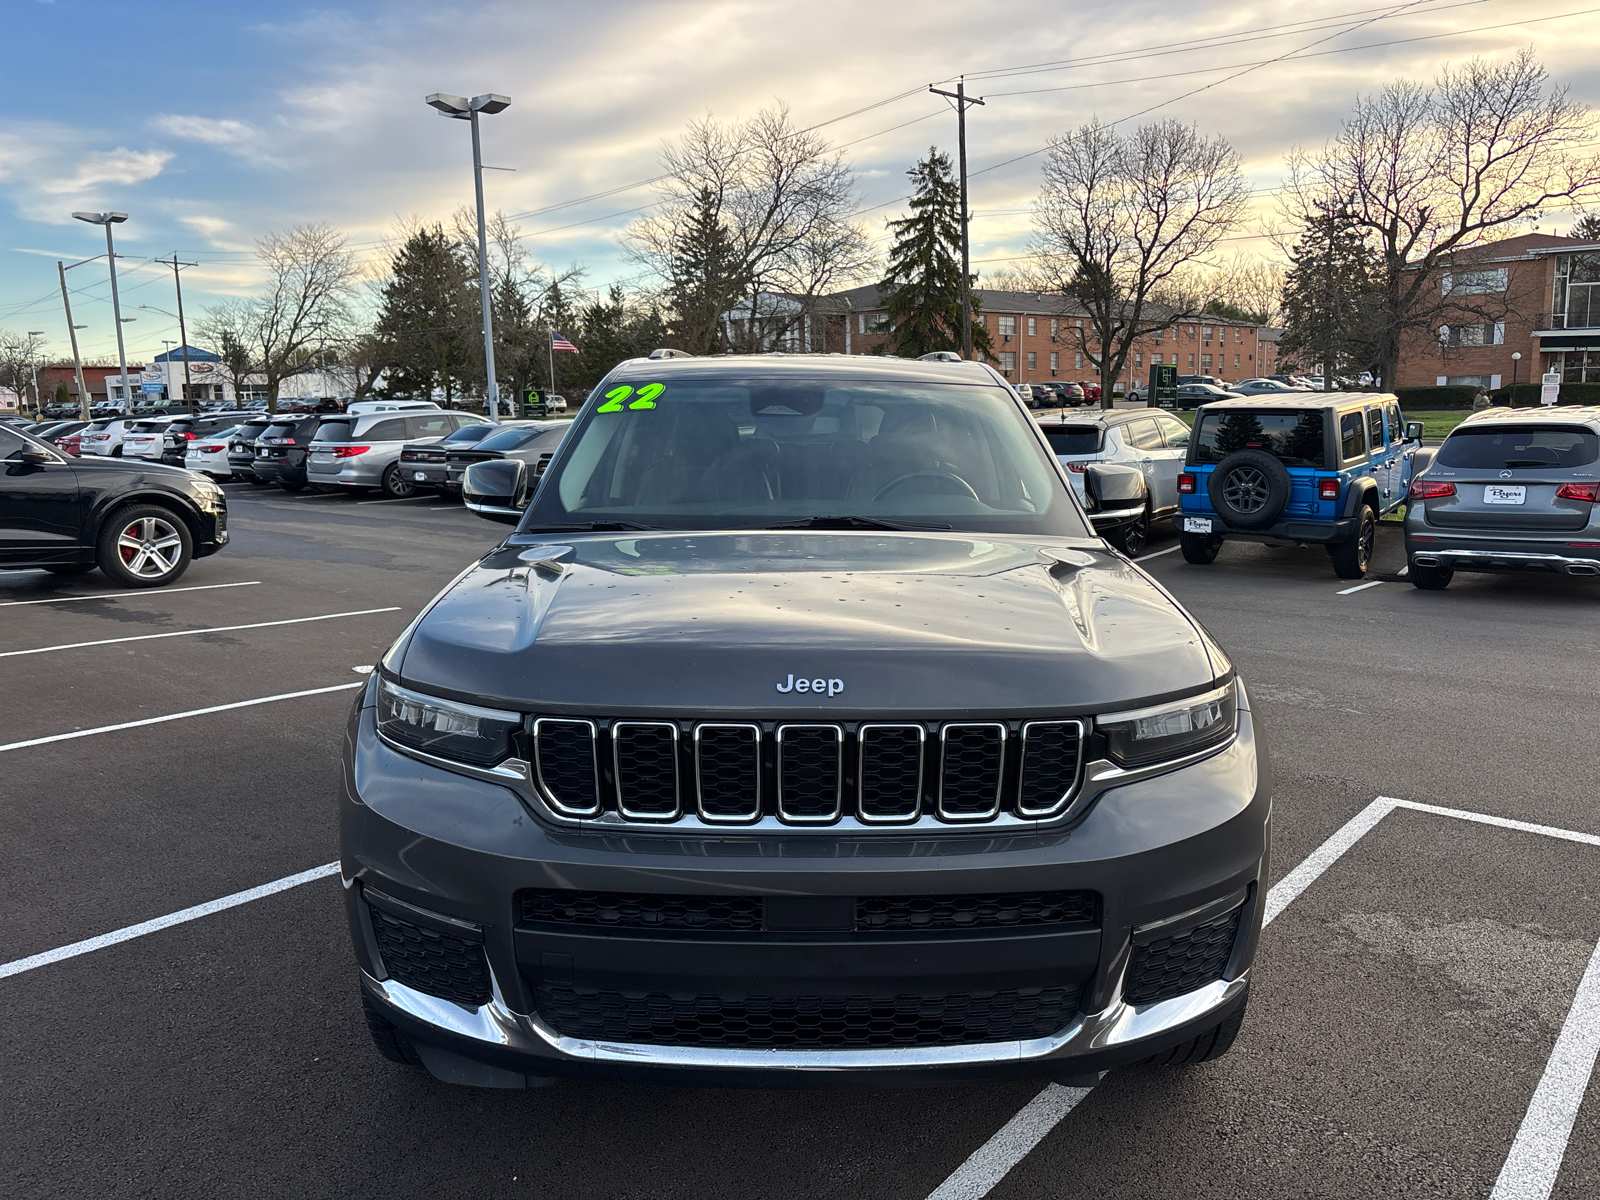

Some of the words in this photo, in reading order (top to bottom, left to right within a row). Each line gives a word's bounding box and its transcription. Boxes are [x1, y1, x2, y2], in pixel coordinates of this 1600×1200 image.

[597, 383, 667, 413] 22
[1489, 489, 1522, 498] Byers
[776, 673, 844, 698] Jeep
